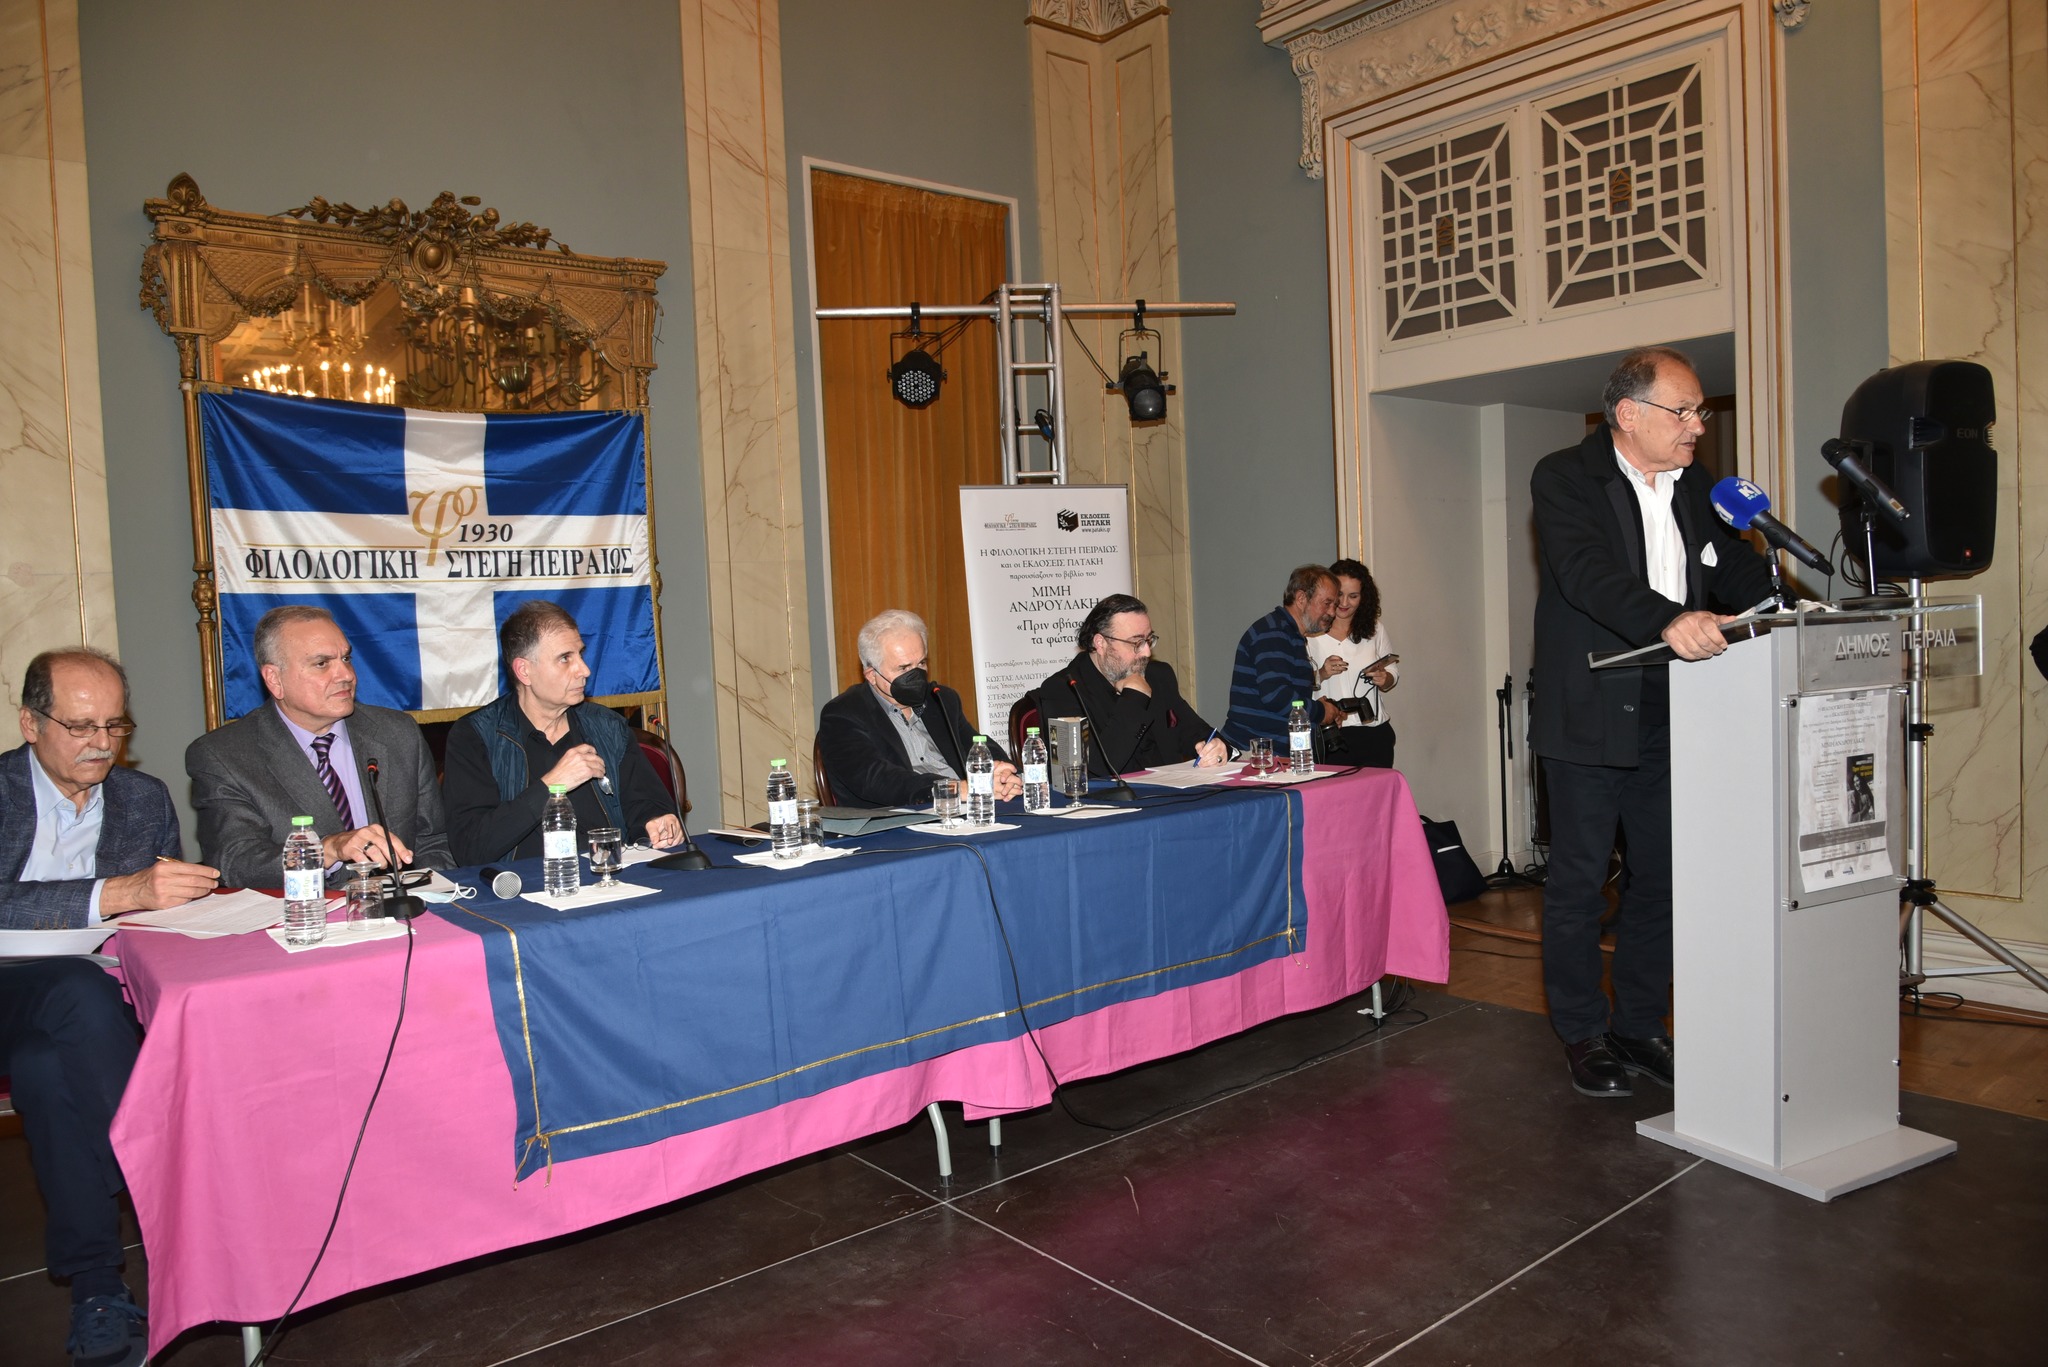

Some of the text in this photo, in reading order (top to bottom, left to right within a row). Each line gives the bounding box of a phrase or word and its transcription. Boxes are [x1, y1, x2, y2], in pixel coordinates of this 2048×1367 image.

[1956, 427, 1978, 439] EON
[458, 522, 513, 543] 1930
[980, 545, 1119, 557] Η ΦΙΛΟΛΟΓΙΚΗ ΣΤΕΓΗ ΠΕΙΡΑΙΩΣ
[245, 547, 635, 580] ΦΙΛΟΛΟΓΙΚΗ ΣΤΕΓΗ ΠΕΙΡΑΙΩΣ
[1022, 558, 1065, 568] ΕΚΔΟΣΕΙΣ
[1067, 557, 1104, 567] ΠΑΤΑΚΗ
[1063, 569, 1085, 580] βιβλίο
[1031, 585, 1072, 597] ΜΙΜΗ
[1009, 597, 1099, 613] ΑΝΔΡΟΥΛΑΚΗ
[1016, 619, 1050, 634] «Πριν
[1835, 628, 1957, 656] ΔΗΜΟΣ ΠΕΙΡΑΙΑ
[985, 672, 1049, 683] ΚΩΣΤΑΣ ΛΑΛΙΩΤΗΣ
